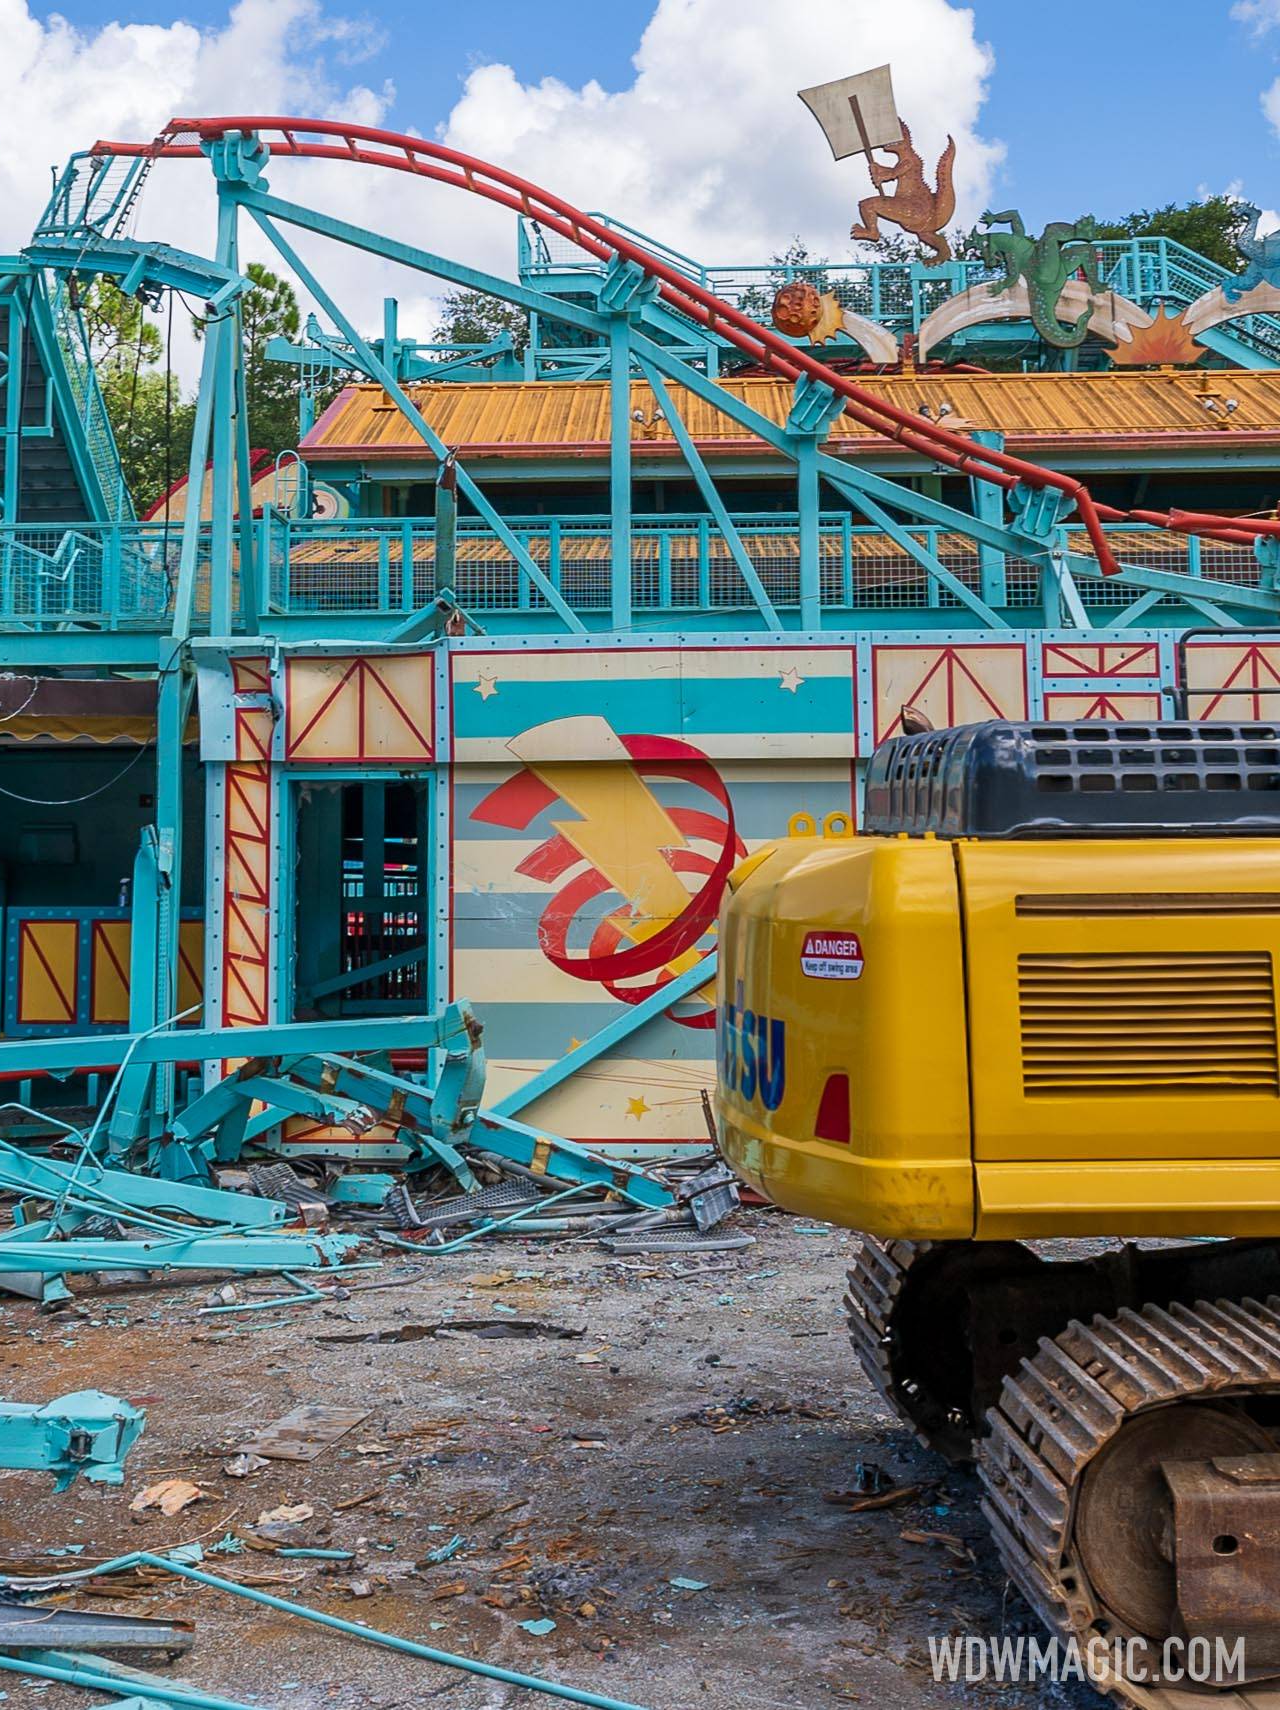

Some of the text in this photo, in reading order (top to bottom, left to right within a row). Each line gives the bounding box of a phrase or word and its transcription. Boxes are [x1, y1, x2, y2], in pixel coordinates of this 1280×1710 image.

[815, 939, 858, 956] DANGER
[805, 961, 858, 975] Keep off swing area
[722, 1003, 786, 1110] TSU
